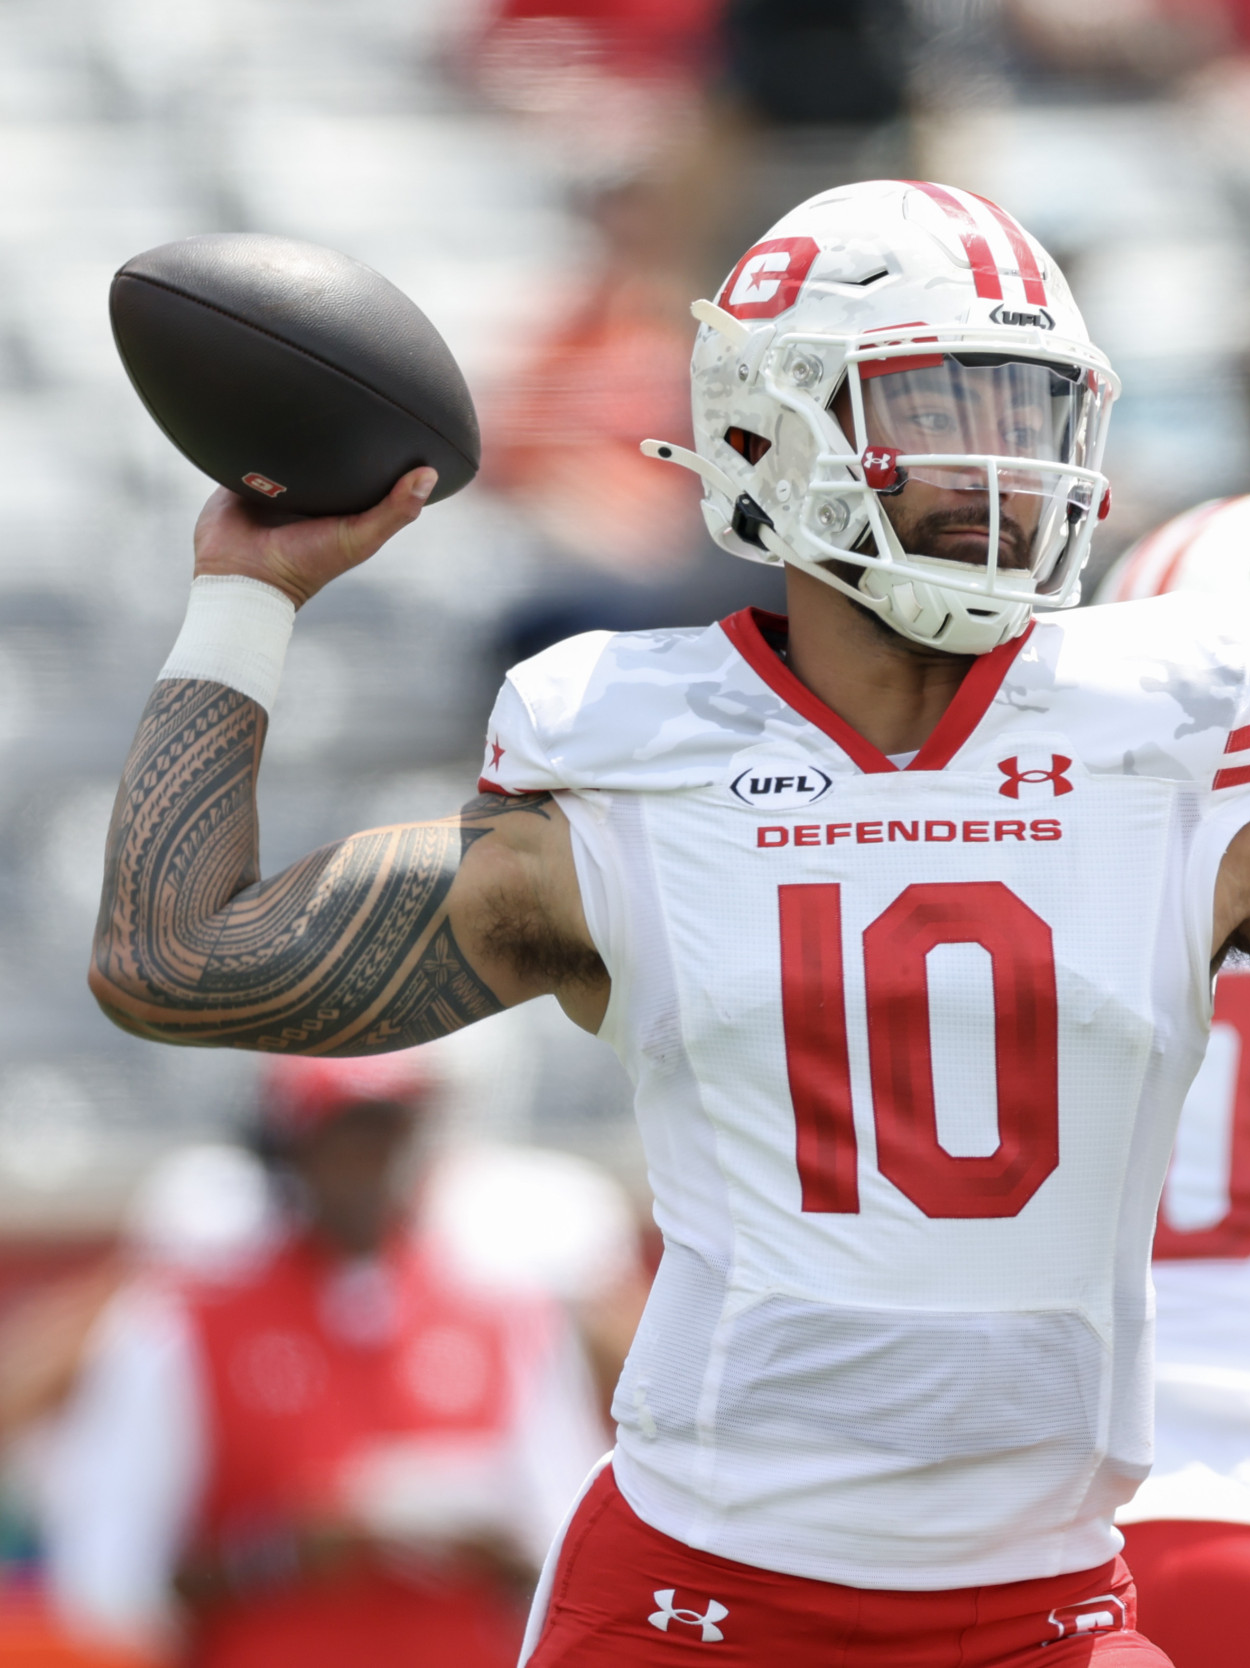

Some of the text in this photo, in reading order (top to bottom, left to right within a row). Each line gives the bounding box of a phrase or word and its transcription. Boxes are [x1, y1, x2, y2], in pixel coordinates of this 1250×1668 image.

[1002, 310, 1047, 330] UFL
[749, 776, 815, 795] UFL
[756, 818, 1063, 848] DEFENDERS
[777, 880, 1060, 1219] 10
